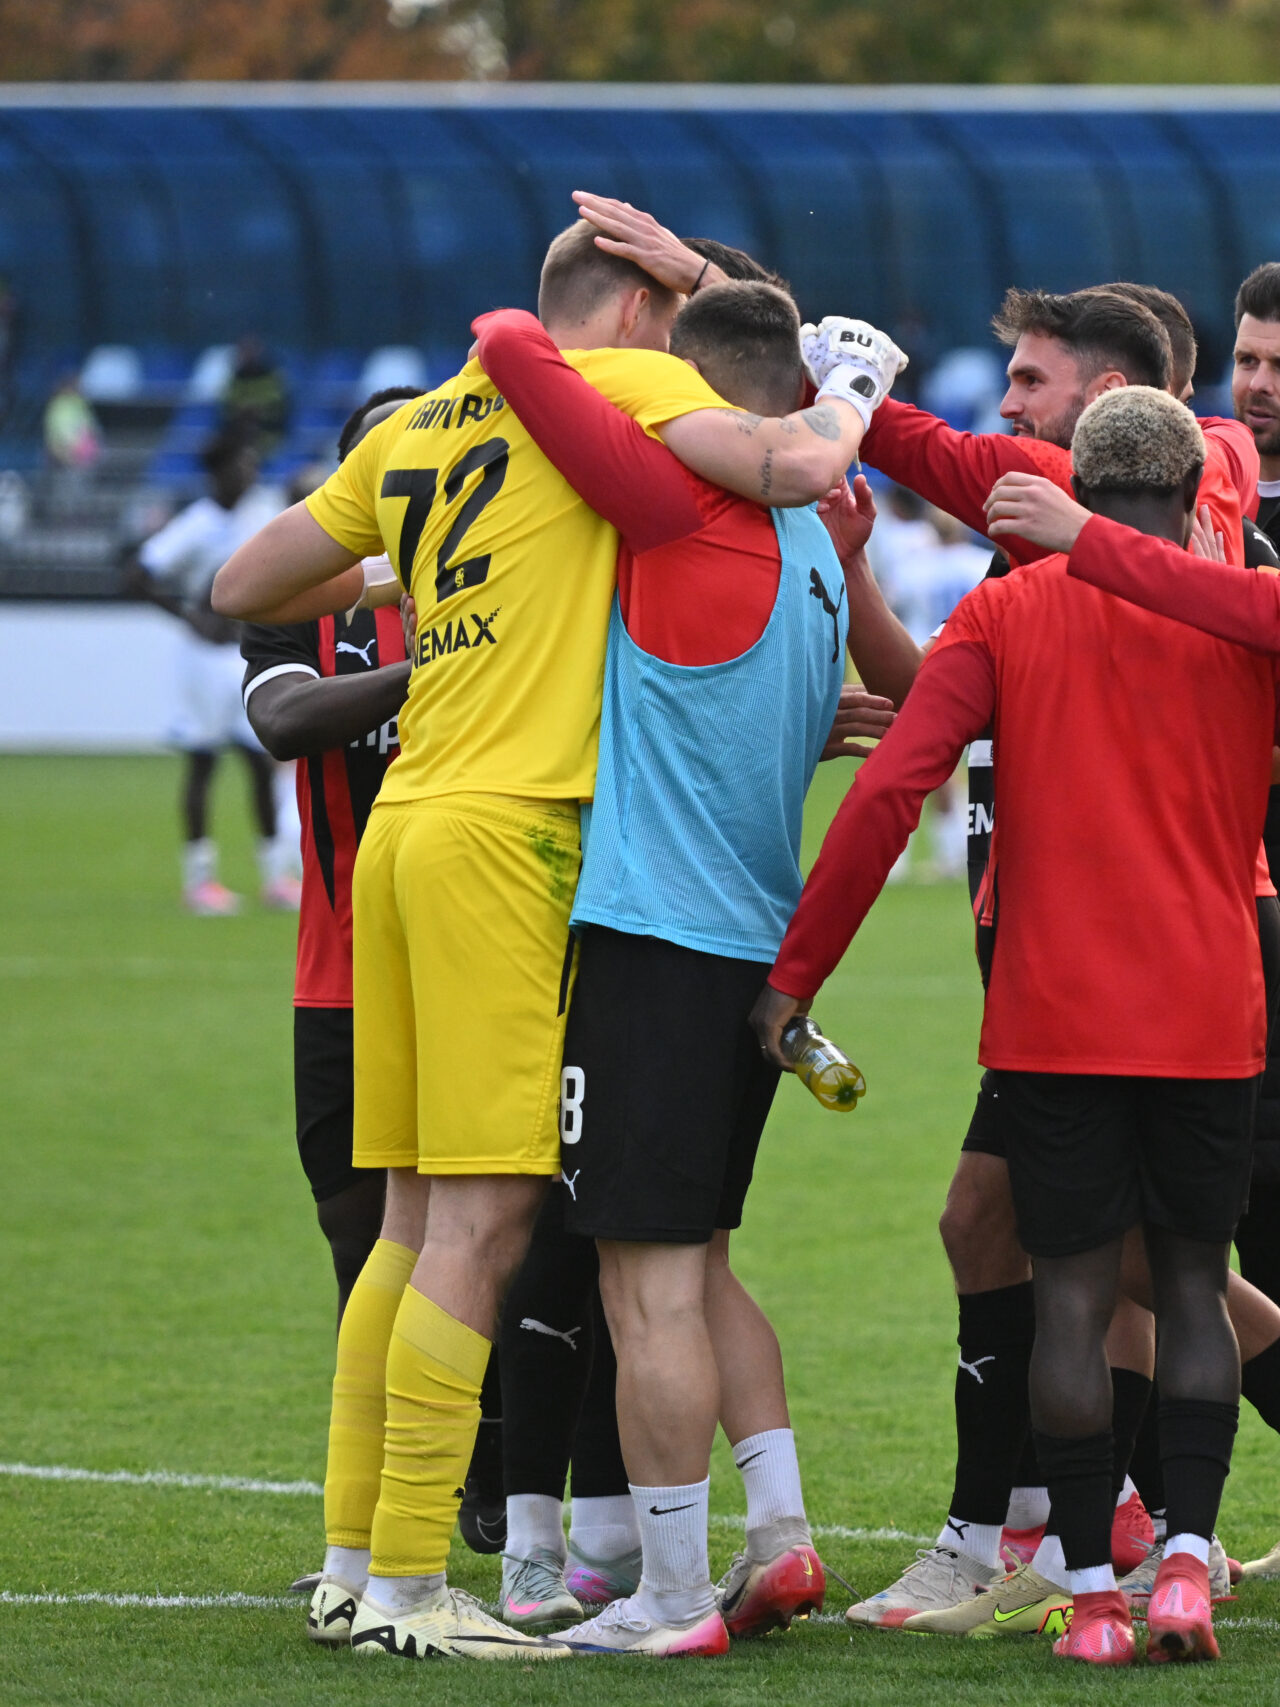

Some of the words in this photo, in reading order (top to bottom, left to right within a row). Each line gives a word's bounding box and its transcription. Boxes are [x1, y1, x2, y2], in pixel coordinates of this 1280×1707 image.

[839, 330, 873, 348] BU
[380, 436, 511, 604] 72
[560, 1065, 586, 1145] 8
